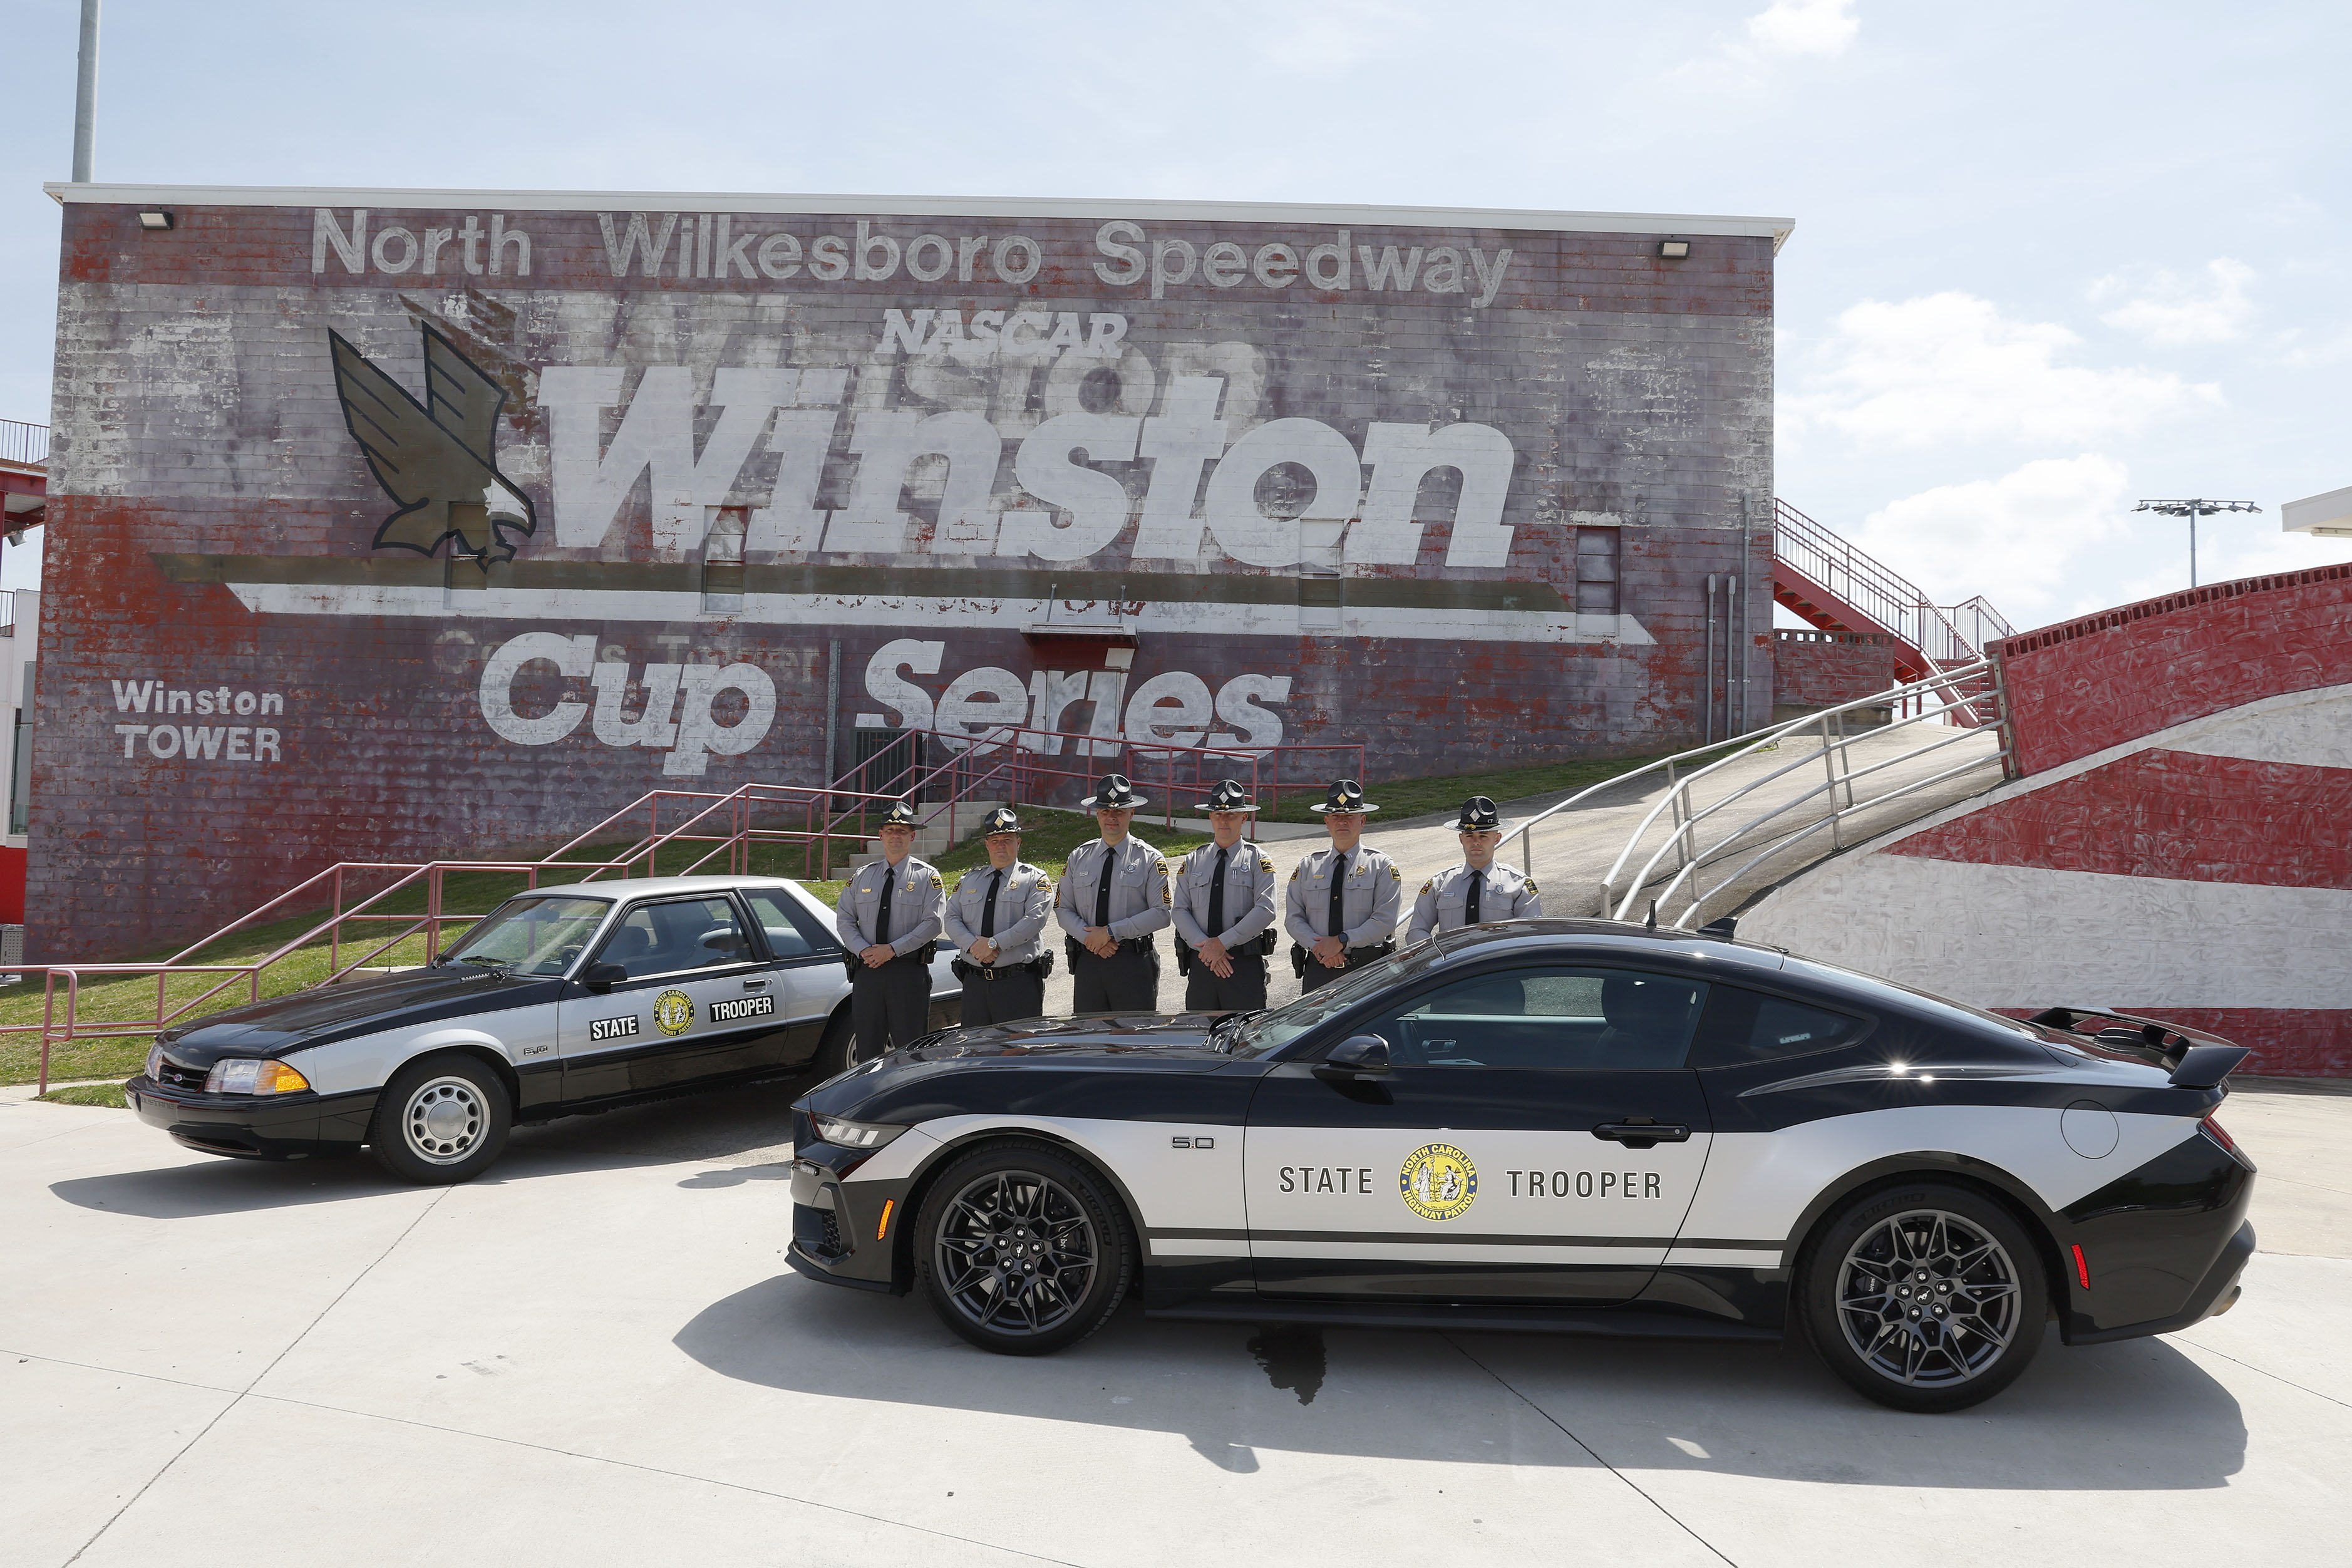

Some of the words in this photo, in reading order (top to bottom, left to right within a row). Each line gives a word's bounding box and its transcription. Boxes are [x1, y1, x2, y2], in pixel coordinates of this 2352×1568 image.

[311, 209, 530, 276] North
[597, 212, 1042, 284] Wilkesboro
[1093, 220, 1513, 308] Speedway
[880, 309, 1128, 359] NASCAR
[537, 366, 1515, 568] Winston
[111, 679, 283, 716] Winston
[480, 631, 775, 775] Cup
[855, 638, 1292, 761] Series
[115, 725, 281, 761] TOWER
[655, 993, 667, 1011] NORTH
[668, 991, 692, 1007] CAROLINA
[712, 997, 772, 1020] TROOPER
[592, 1017, 637, 1039] STATE
[656, 1020, 677, 1035] HIGHWAY
[679, 1016, 693, 1034] PATROL
[524, 1045, 548, 1056] 5.0
[1171, 1136, 1215, 1150] 5.0
[1402, 1147, 1430, 1175] NORTH
[1431, 1145, 1475, 1177] CAROLINA
[1278, 1166, 1373, 1195] STATE
[1506, 1170, 1662, 1200] TROOPER
[1403, 1190, 1442, 1219] HIGHWAY
[1445, 1192, 1475, 1219] PATROL
